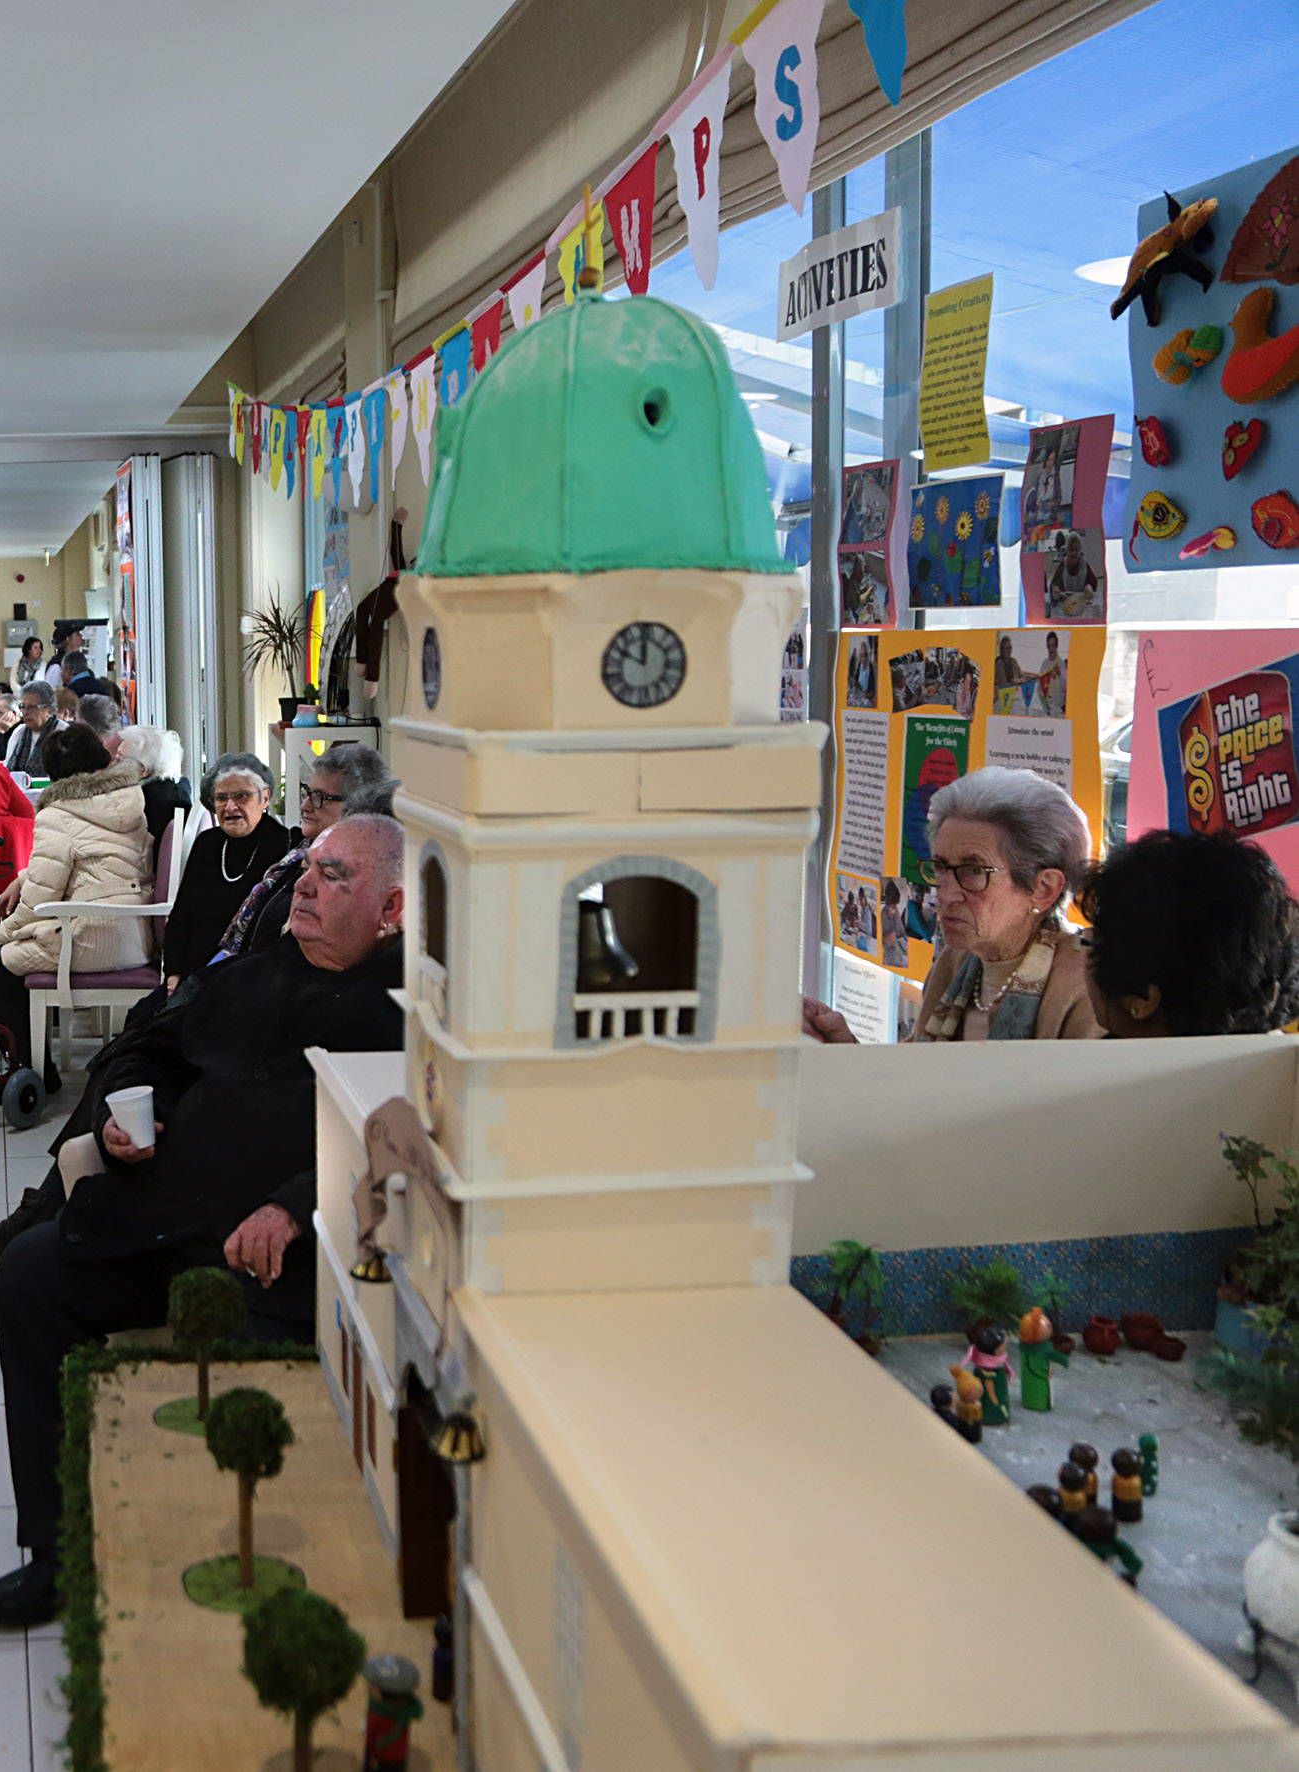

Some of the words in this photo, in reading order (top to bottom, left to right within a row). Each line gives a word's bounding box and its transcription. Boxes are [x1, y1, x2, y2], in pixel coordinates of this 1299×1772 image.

[784, 237, 888, 328] ACTIVITIES
[1214, 692, 1261, 734] the
[1031, 728, 1039, 736] the
[989, 749, 1011, 760] Learning
[1220, 759, 1243, 792] is
[1223, 773, 1292, 828] Right
